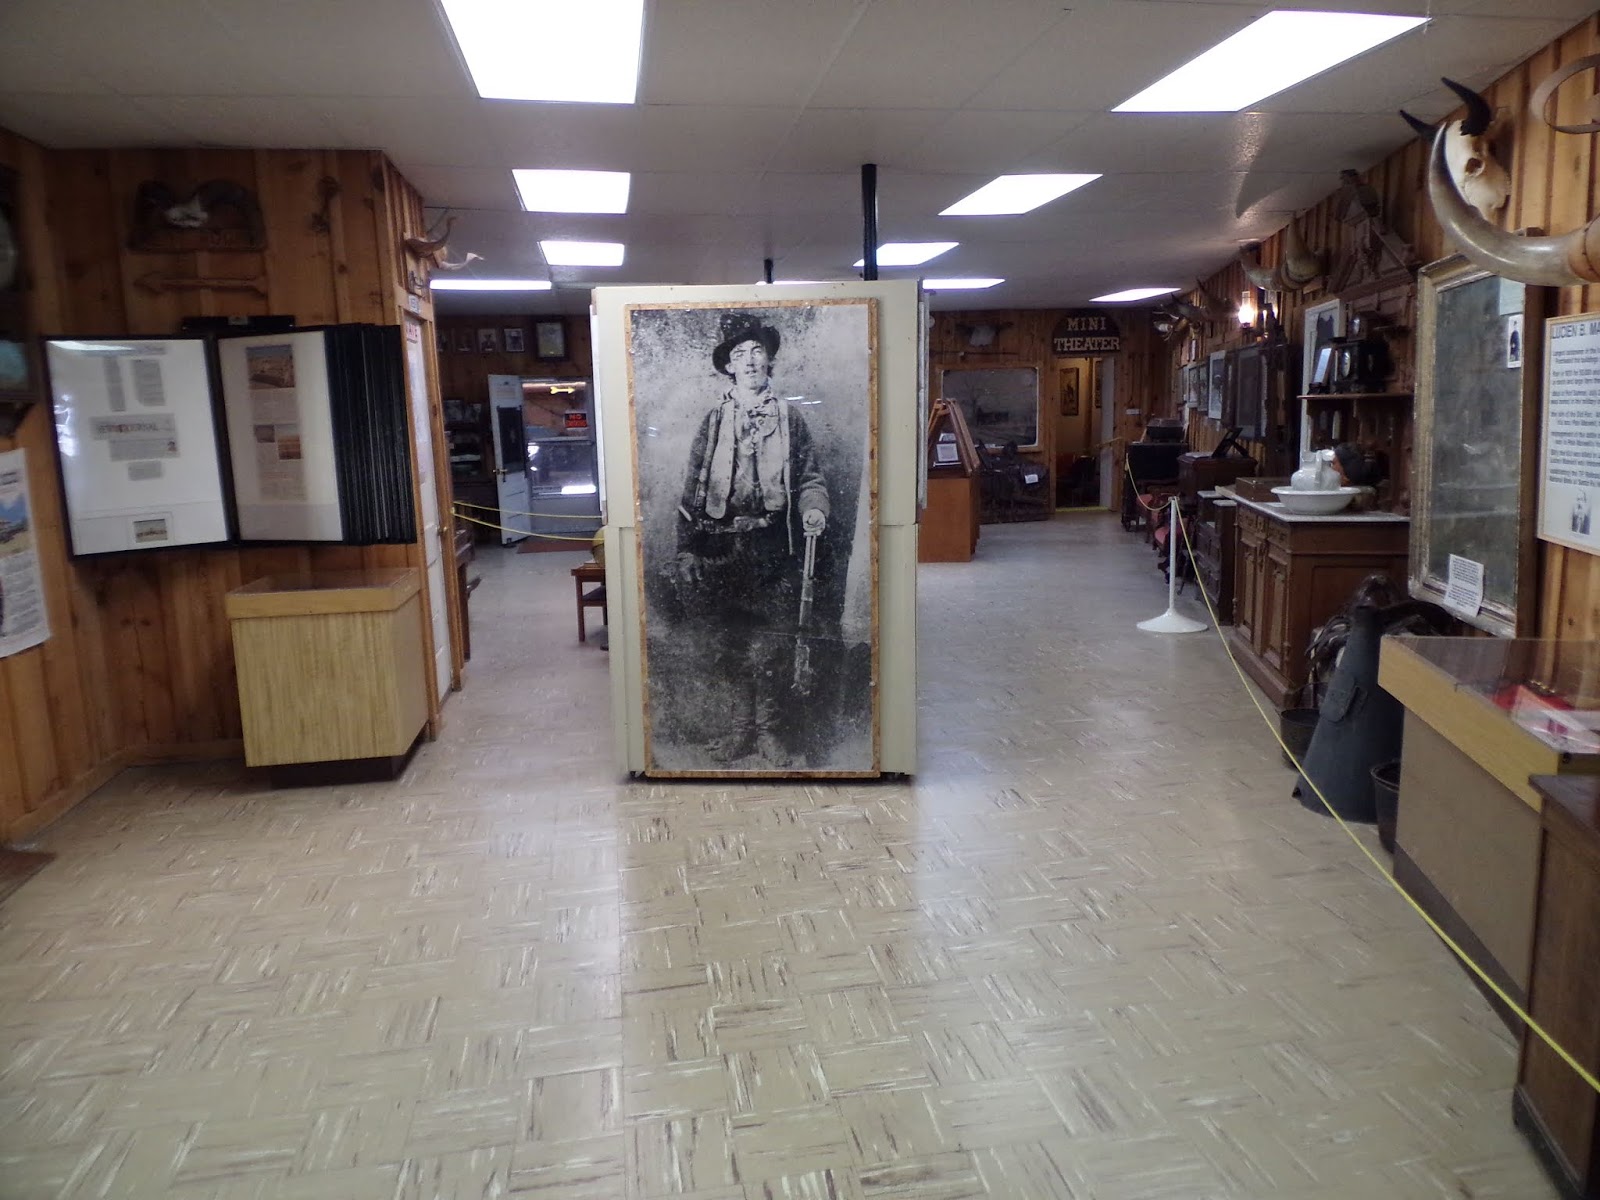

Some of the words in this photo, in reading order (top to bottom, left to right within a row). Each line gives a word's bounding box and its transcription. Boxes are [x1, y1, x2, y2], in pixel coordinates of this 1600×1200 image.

[1067, 317, 1106, 331] MINI
[1551, 325, 1578, 339] LUCIEN
[1054, 336, 1120, 351] THEATER
